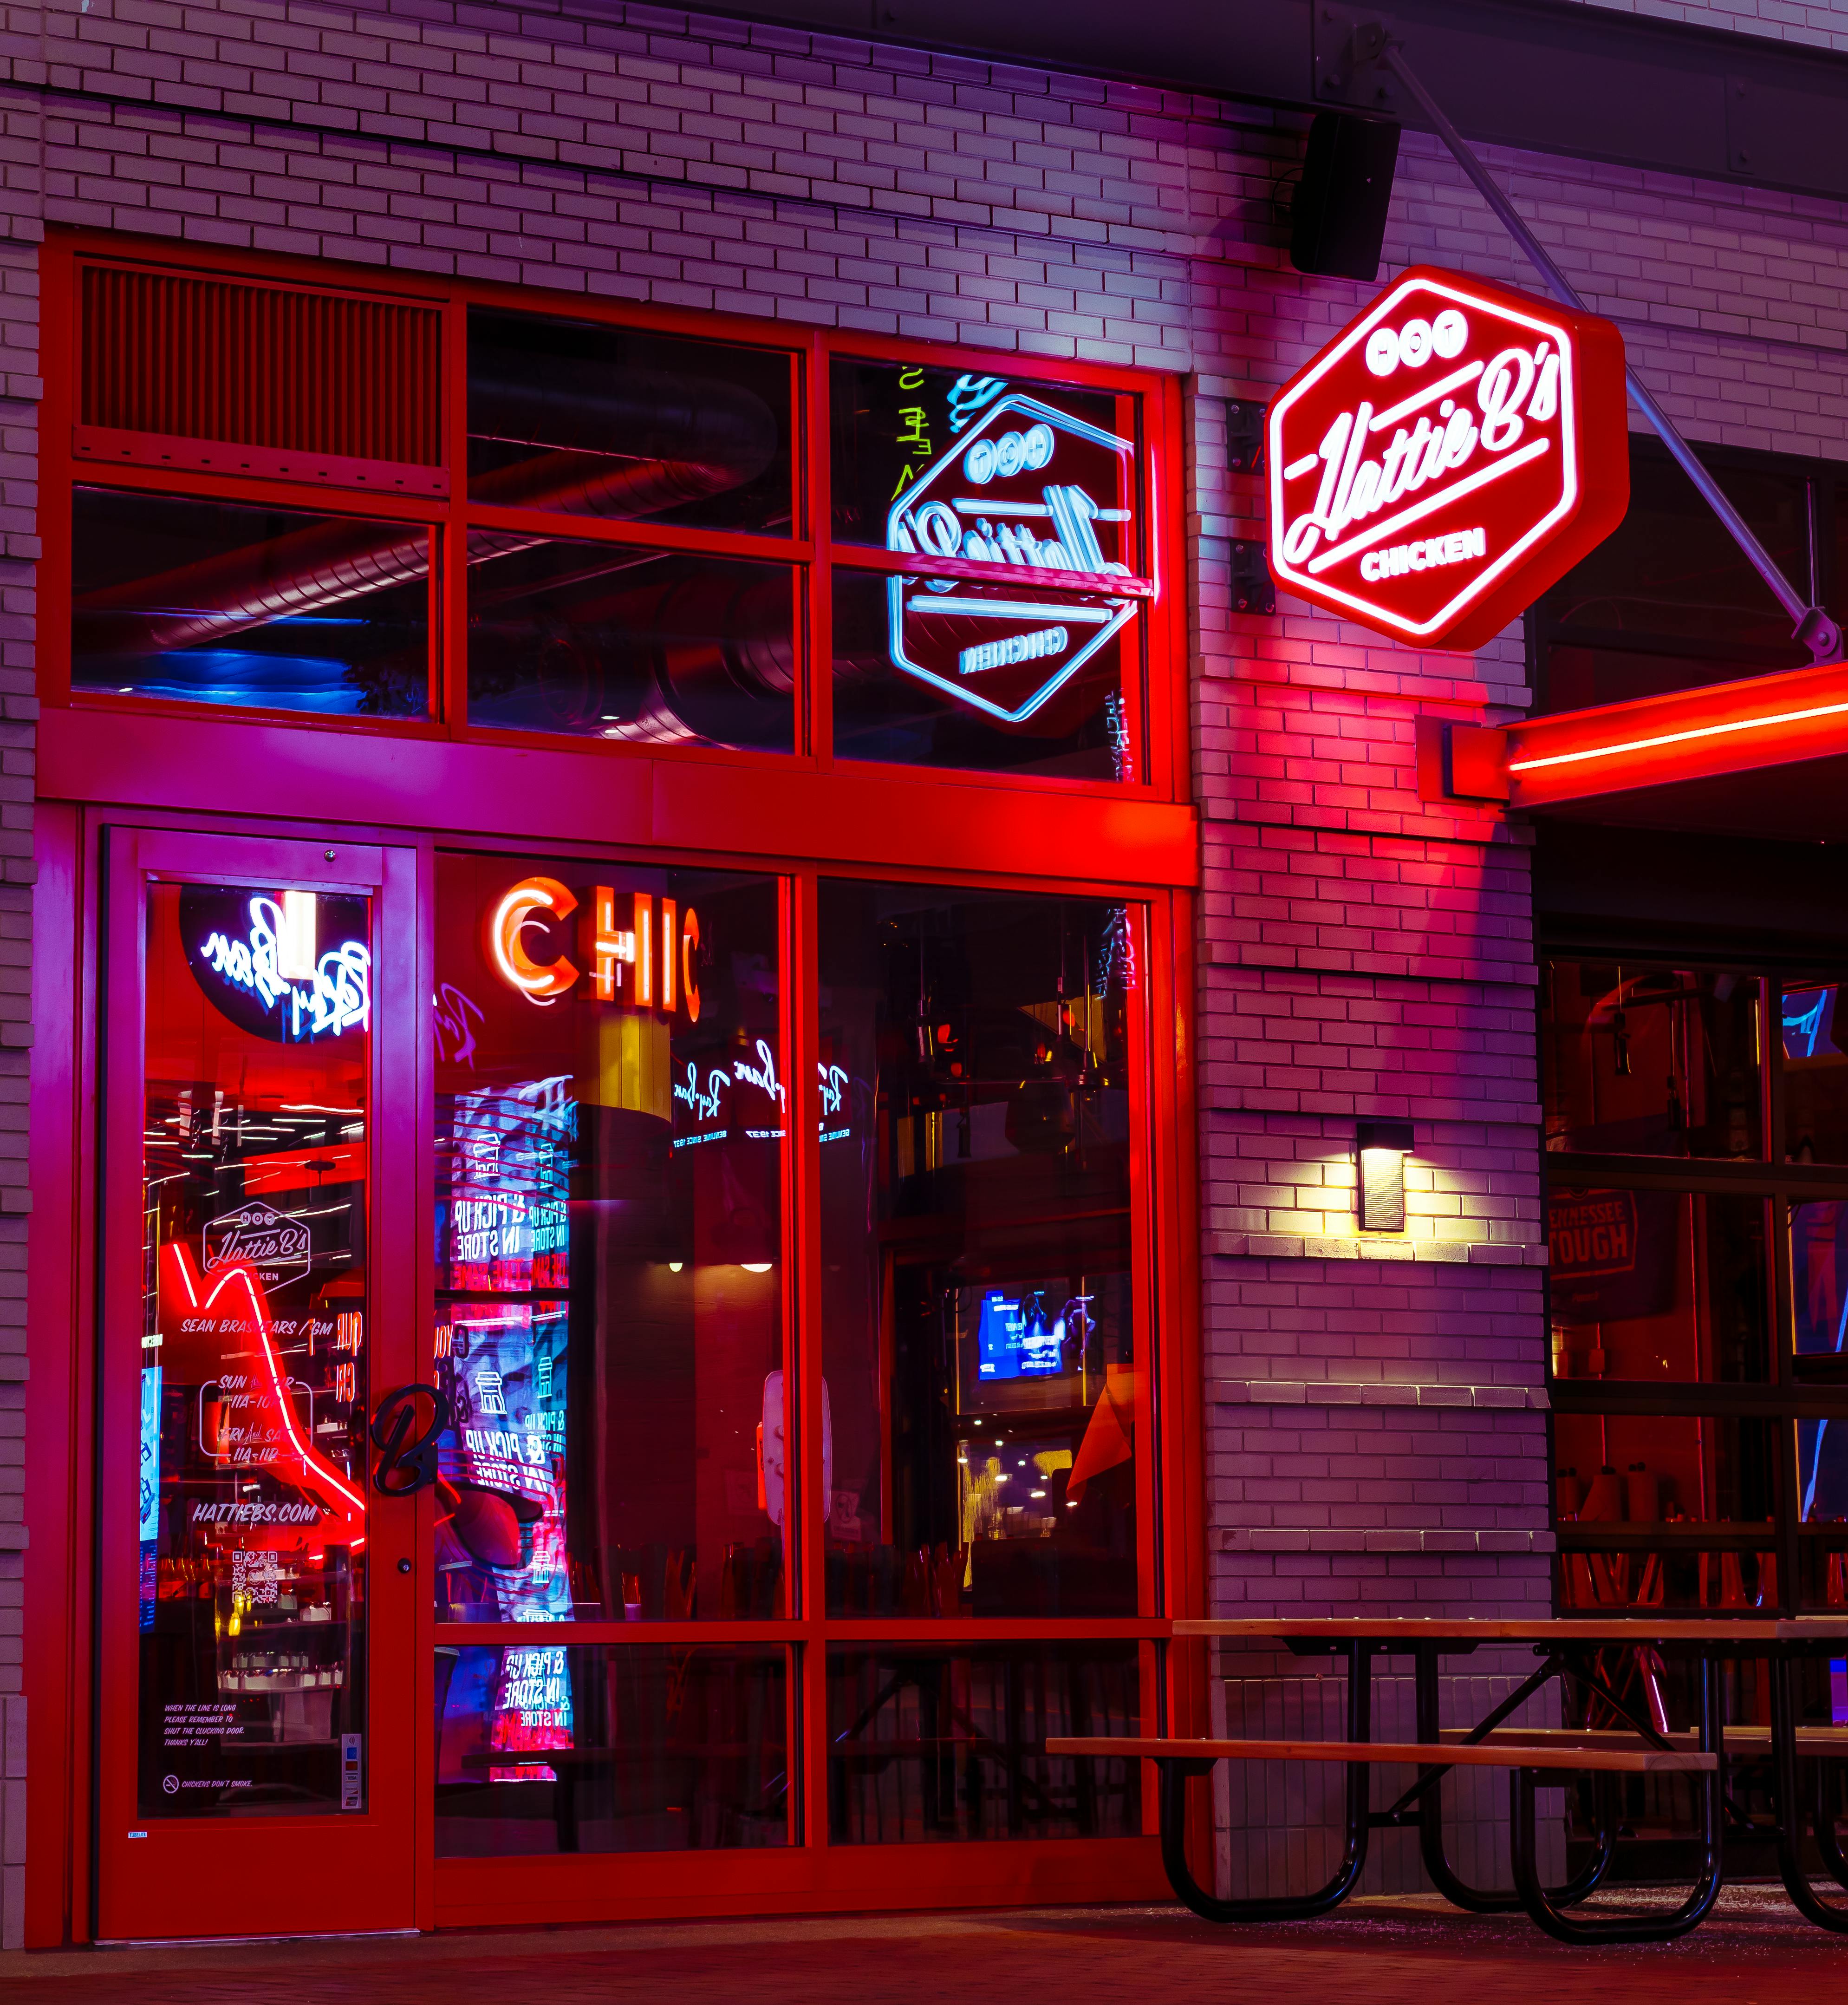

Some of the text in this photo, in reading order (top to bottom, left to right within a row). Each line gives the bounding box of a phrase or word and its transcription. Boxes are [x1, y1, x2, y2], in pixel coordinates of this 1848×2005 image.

[1366, 309, 1468, 376] HOT
[1283, 341, 1560, 565] Hattie B's
[1360, 527, 1485, 582] CHICKEN
[240, 1212, 275, 1226] HOT
[1549, 1201, 1625, 1229] ENNESSEE
[207, 1228, 307, 1269] Hattie B's
[180, 1319, 216, 1333] SEAN
[311, 1322, 333, 1336] GM
[218, 1375, 247, 1389] SUN
[192, 1503, 318, 1522] HATTIEBS.COM
